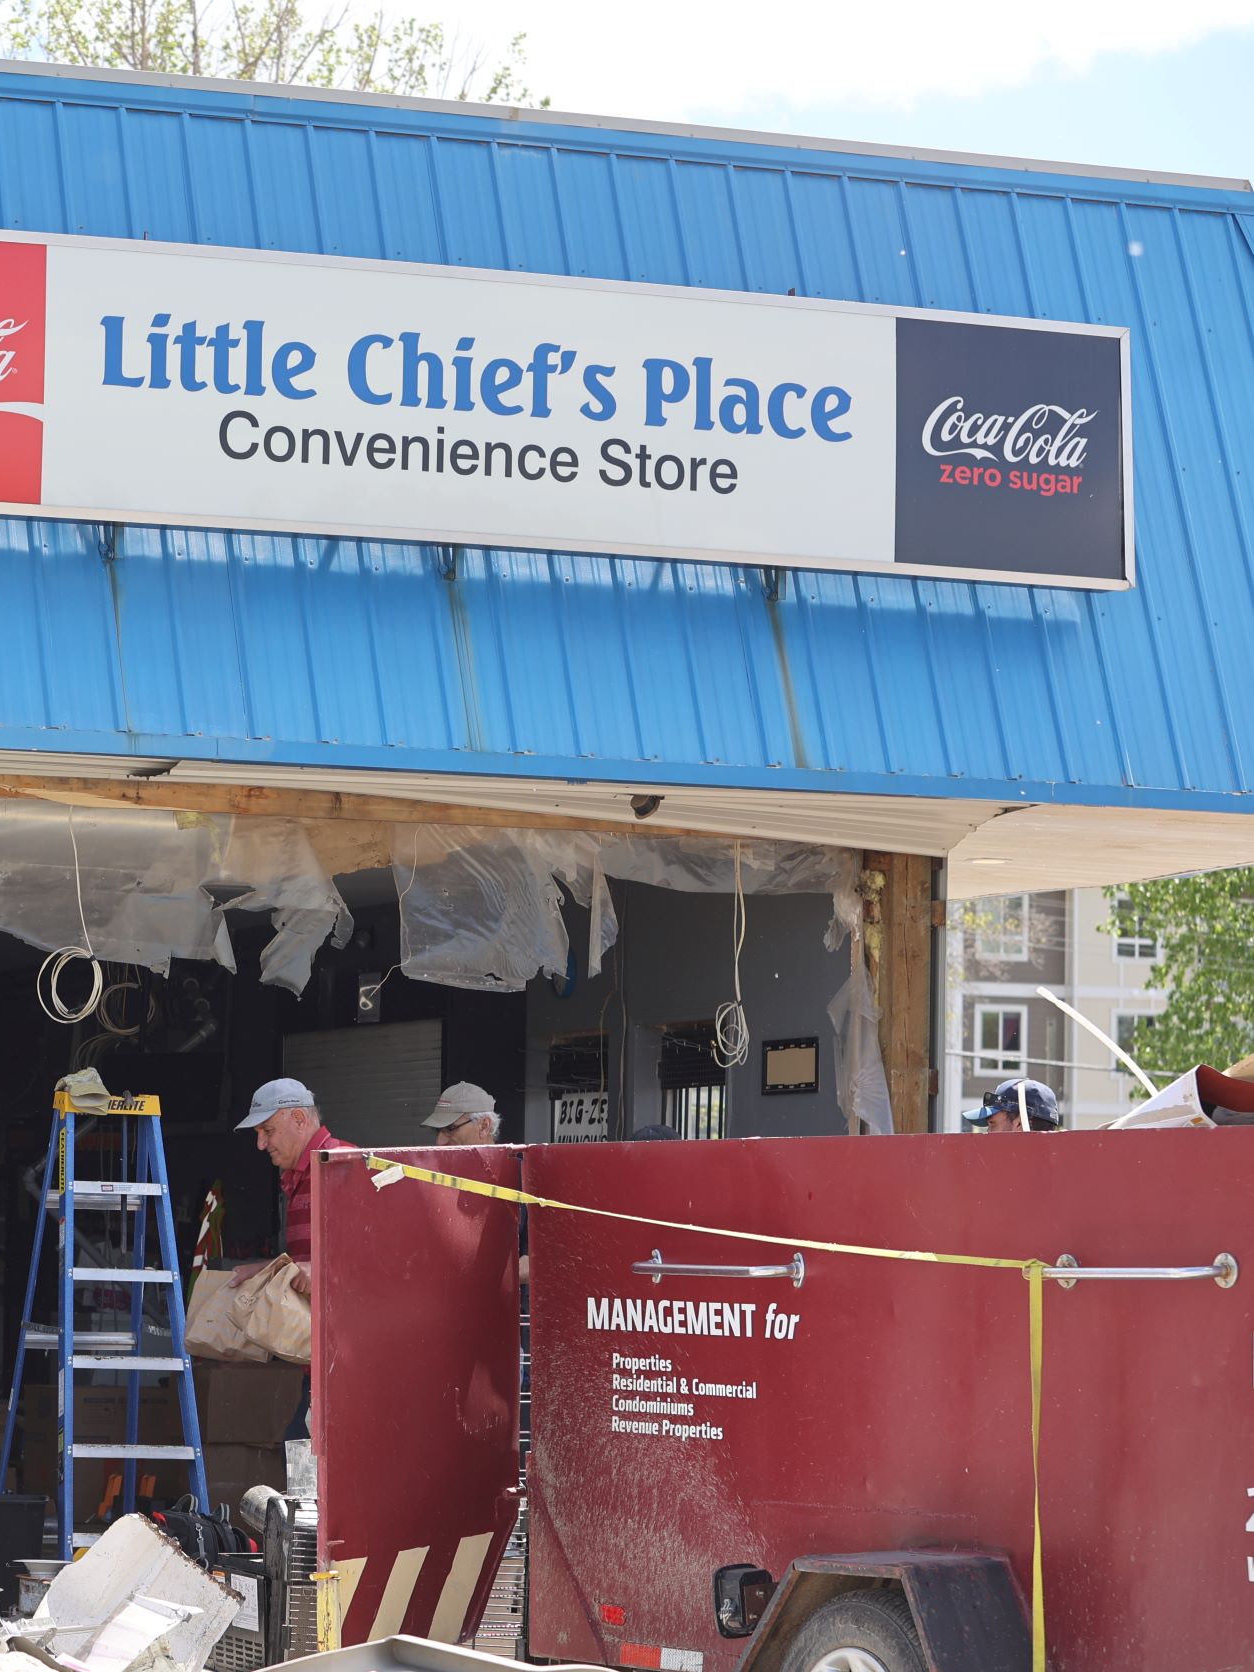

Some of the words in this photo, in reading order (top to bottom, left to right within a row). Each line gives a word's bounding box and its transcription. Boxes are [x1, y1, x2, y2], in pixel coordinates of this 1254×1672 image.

[100, 313, 317, 399] Little
[347, 331, 616, 422] Chief's
[643, 357, 853, 443] Place
[922, 396, 1099, 469] Coca-Cola
[218, 409, 579, 482] Convenience
[598, 438, 739, 495] Store
[939, 464, 1001, 488] zero
[1009, 470, 1083, 496] sugar
[587, 1297, 756, 1337] MANAGEMENT
[764, 1303, 800, 1340] for
[612, 1353, 672, 1373] Properties
[612, 1374, 677, 1394] Residential
[680, 1378, 689, 1394] &
[692, 1379, 757, 1399] Commercial
[612, 1395, 694, 1416] Condominiums
[612, 1416, 659, 1435] Revenue
[662, 1420, 723, 1441] Properties
